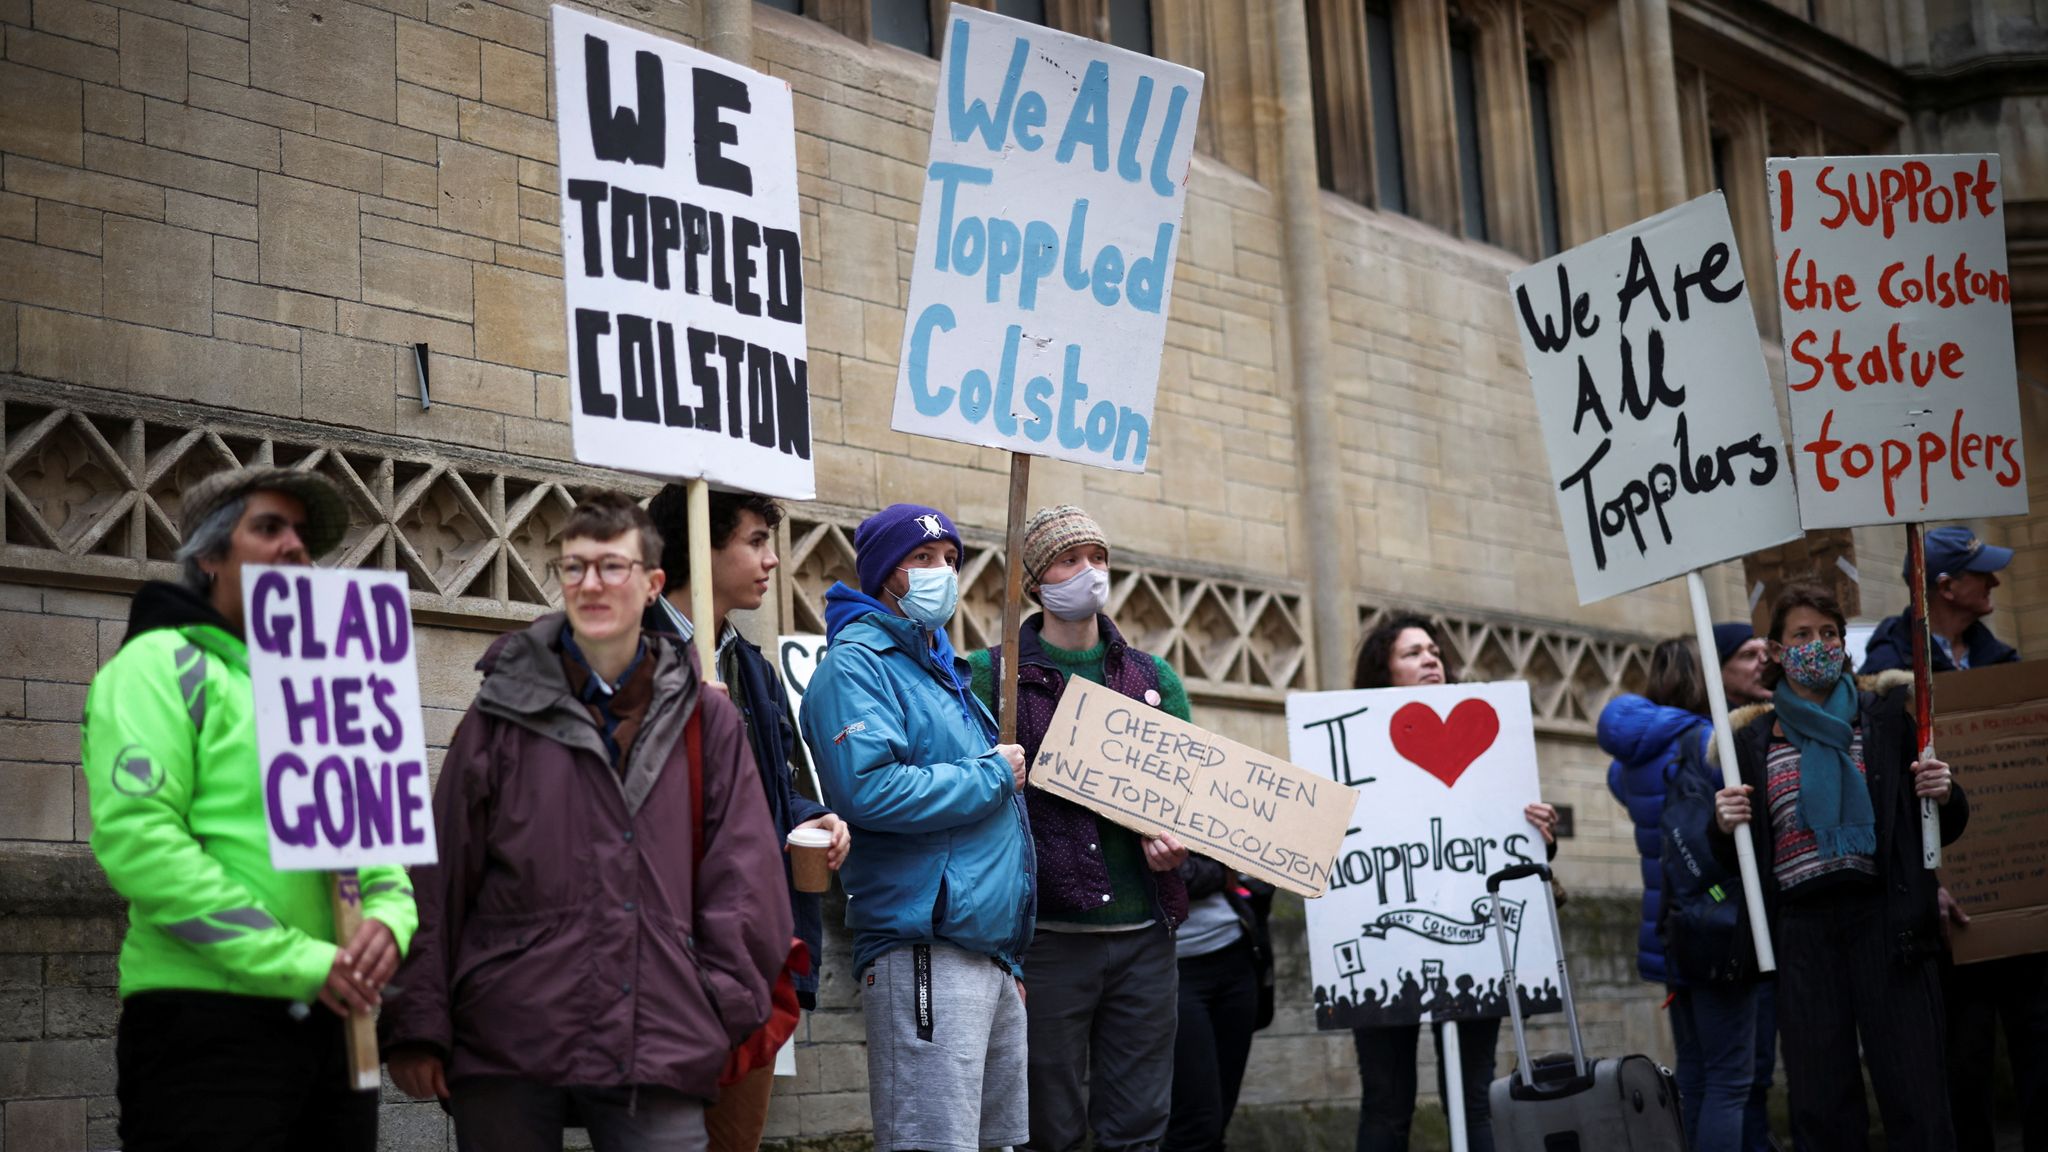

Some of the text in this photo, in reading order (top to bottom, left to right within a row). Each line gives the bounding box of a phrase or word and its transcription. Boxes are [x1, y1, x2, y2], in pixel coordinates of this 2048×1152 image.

[585, 33, 752, 196] WE
[948, 19, 1189, 196] We All
[568, 179, 802, 324] TOPPLED
[929, 162, 1173, 313] Toppled
[1779, 170, 1793, 232] I
[1516, 236, 1744, 352] We Are
[1784, 248, 2010, 312] the Colston
[576, 308, 810, 459] COLSTON
[908, 304, 1149, 464] Colston
[1573, 327, 1685, 434] All
[1790, 323, 1965, 391] Statue
[1560, 412, 1778, 570] Topplers
[1804, 409, 2021, 516] topplers
[252, 571, 408, 663] GLAD
[280, 673, 402, 753] HE'S
[1075, 693, 1317, 808] I CHEERED THEN
[1303, 707, 1376, 786] I
[267, 753, 424, 848] GONE
[1070, 726, 1277, 822] I CHEER NOW
